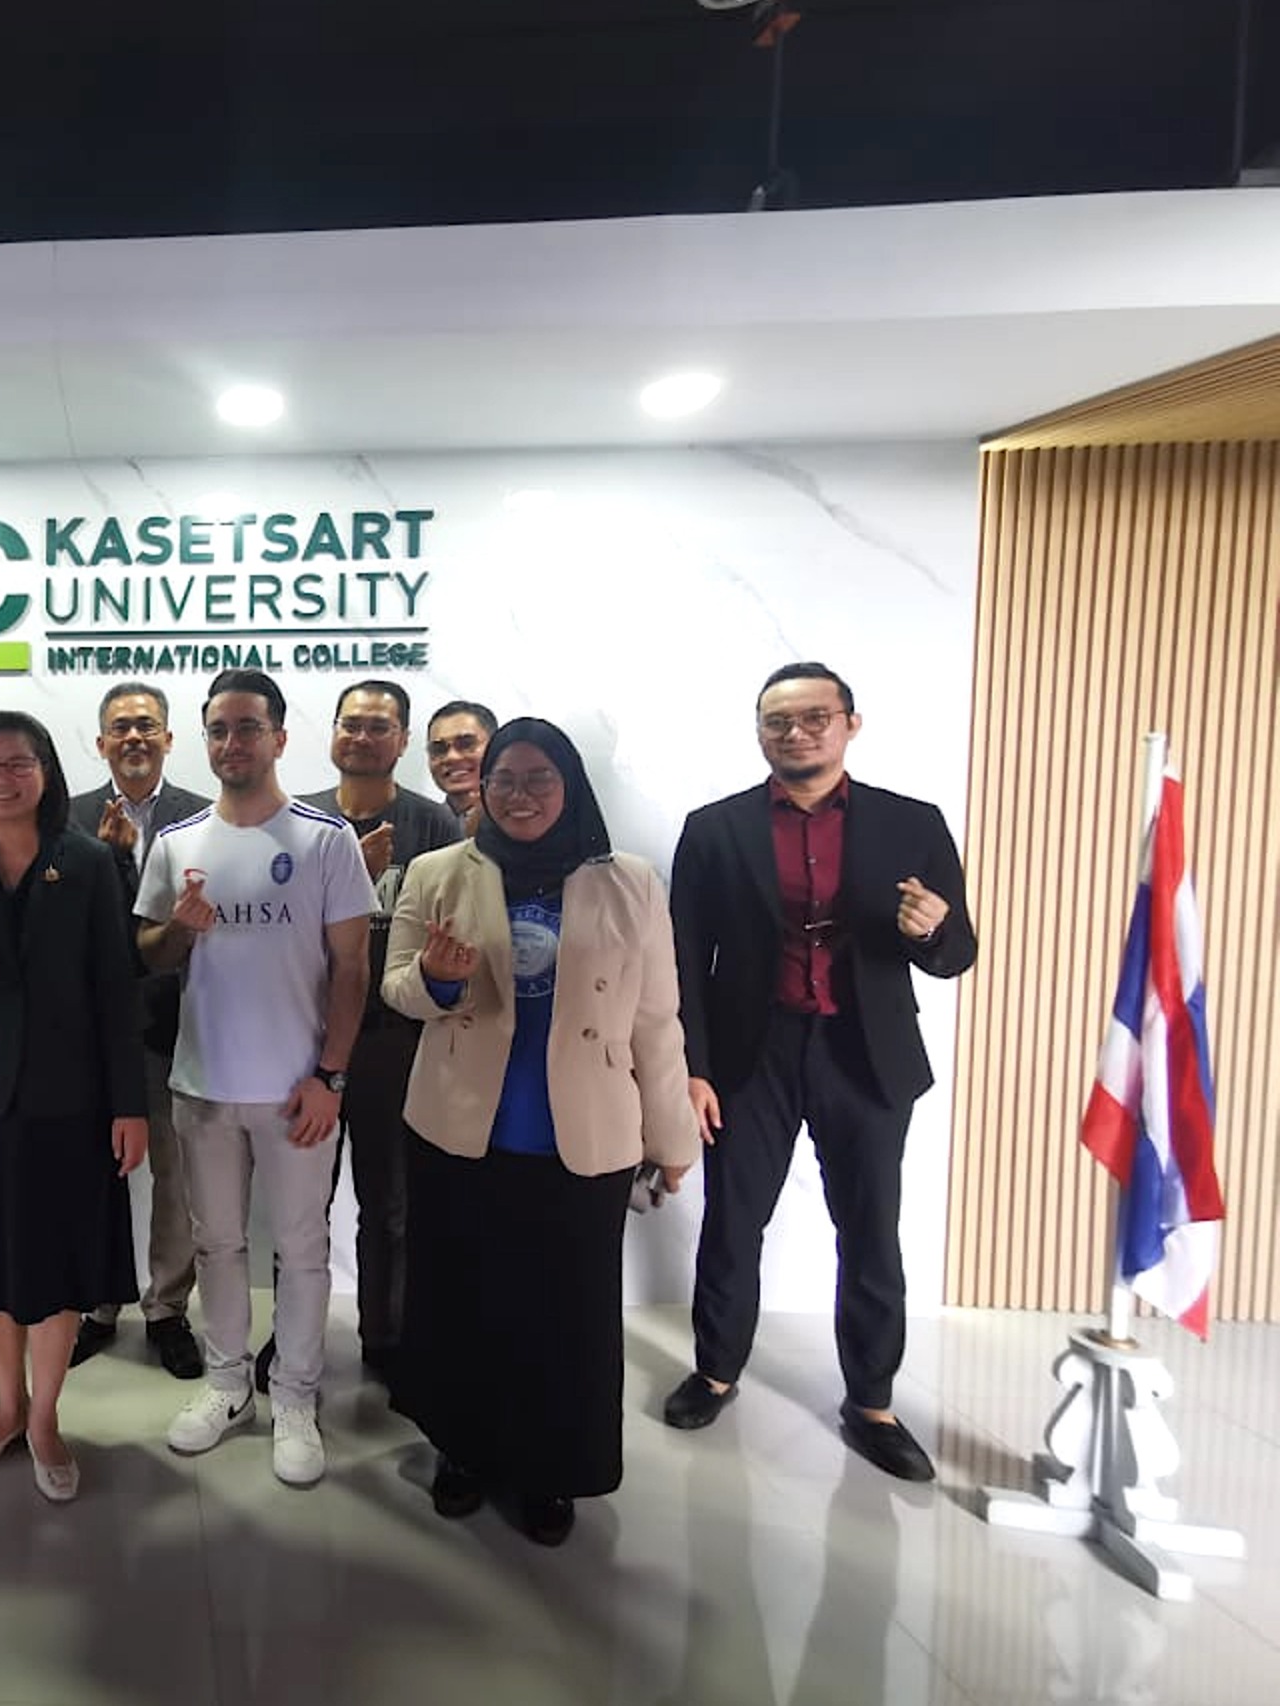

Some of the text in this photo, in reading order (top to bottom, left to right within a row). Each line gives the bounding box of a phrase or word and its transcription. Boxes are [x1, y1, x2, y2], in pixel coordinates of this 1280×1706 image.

[46, 510, 435, 565] KASETSART
[45, 571, 430, 624] UNIVERSITY
[47, 643, 429, 672] INTERNATIONAL COLLEGE
[213, 902, 291, 924] AHSA
